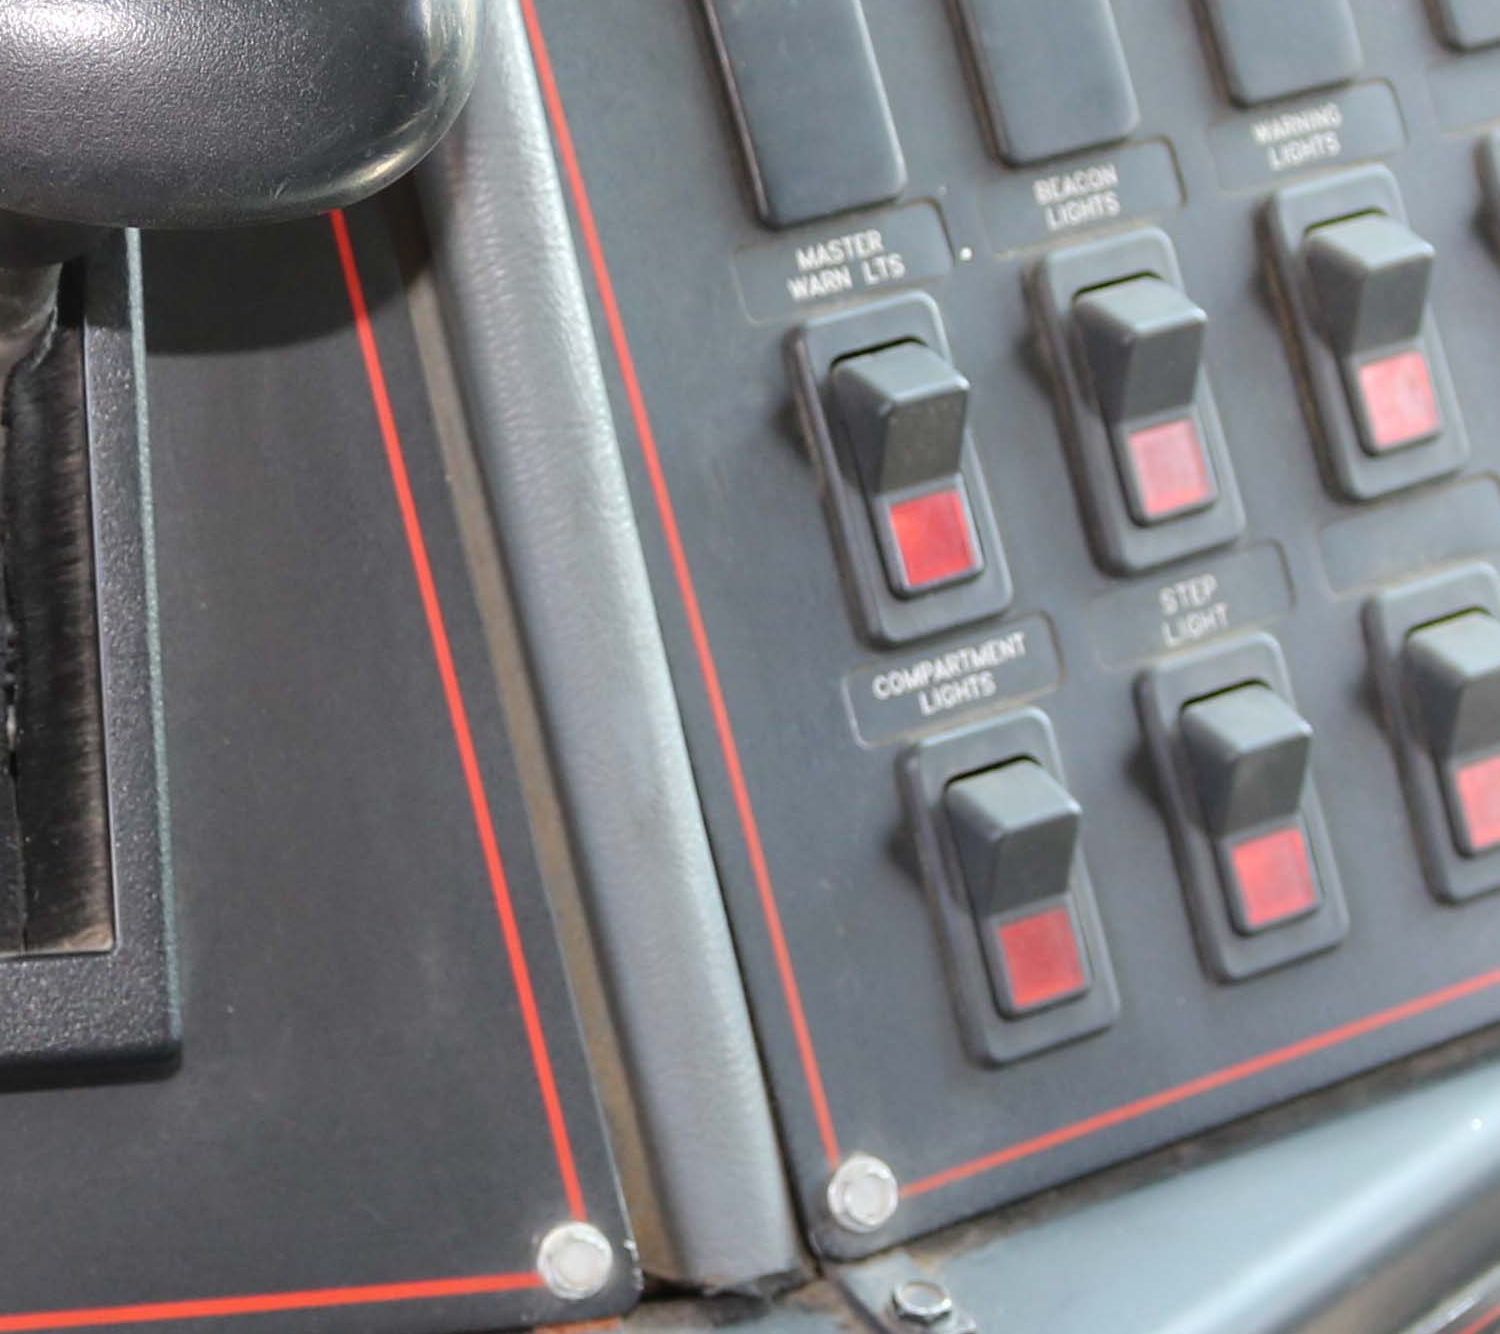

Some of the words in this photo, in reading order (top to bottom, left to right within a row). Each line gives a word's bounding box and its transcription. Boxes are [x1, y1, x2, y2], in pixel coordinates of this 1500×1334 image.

[1252, 102, 1343, 146] WARNING
[1268, 130, 1342, 171] LIGHTS
[1032, 164, 1119, 205] BEACON
[1046, 190, 1121, 231] LIGHTS
[794, 228, 885, 270] MASTER
[786, 266, 853, 301] WARN
[860, 252, 907, 285] LTS
[1158, 573, 1218, 616] STEP
[1161, 602, 1229, 648] LIGHT
[871, 631, 1027, 701] COMPARTMENT
[918, 670, 998, 716] LIGHTS
